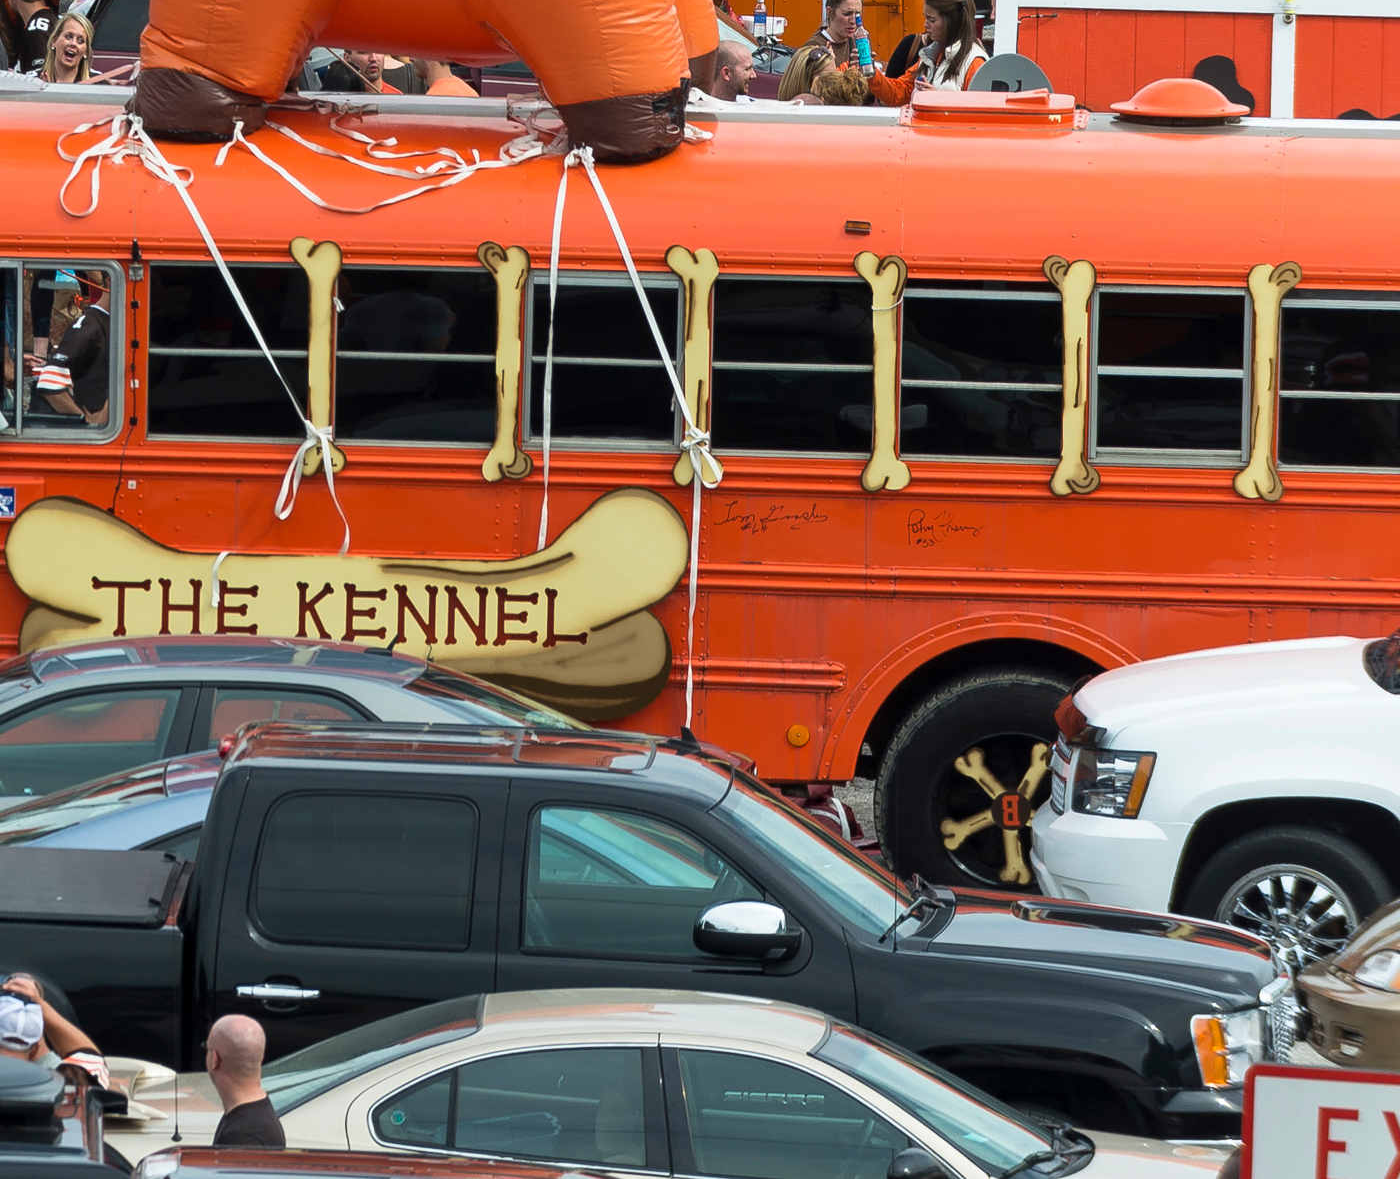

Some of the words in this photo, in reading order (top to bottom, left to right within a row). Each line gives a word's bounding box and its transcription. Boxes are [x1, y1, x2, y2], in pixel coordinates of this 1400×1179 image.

[28, 17, 50, 32] 16
[91, 576, 259, 637] THE
[294, 580, 587, 647] KENNEL
